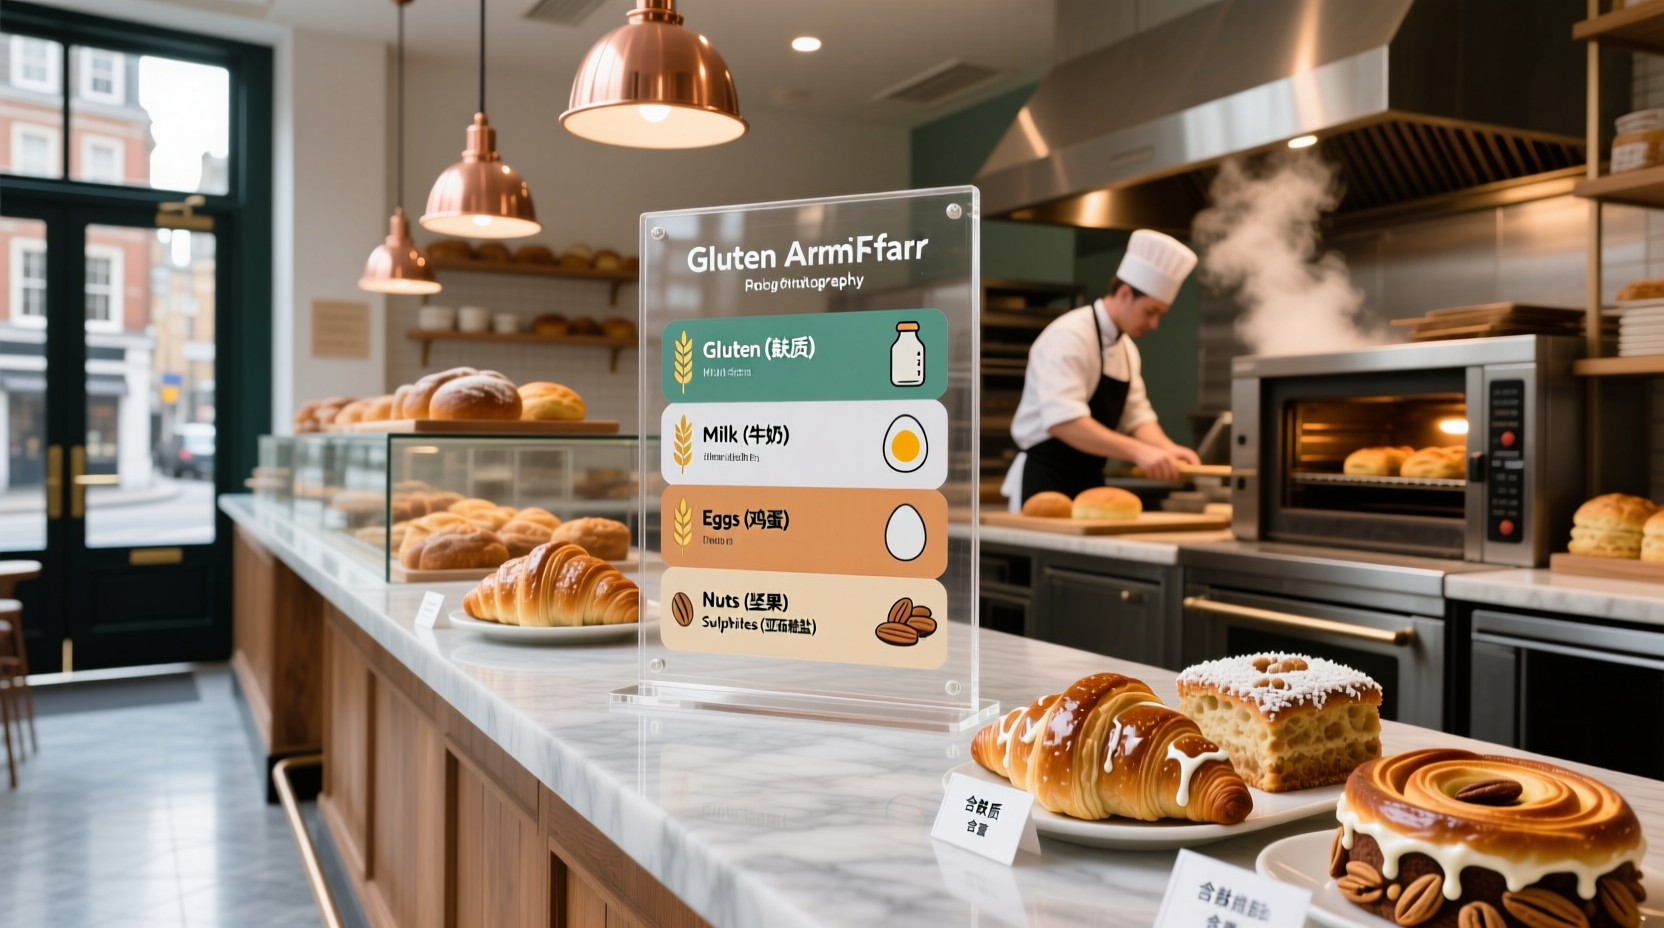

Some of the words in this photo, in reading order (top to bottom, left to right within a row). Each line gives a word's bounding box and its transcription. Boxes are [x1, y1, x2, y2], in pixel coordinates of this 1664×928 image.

[687, 245, 777, 273] Gluten
[703, 340, 760, 358] Gluten
[703, 424, 738, 443] Milk
[703, 509, 740, 530] Eggs
[703, 591, 740, 608] Nuts
